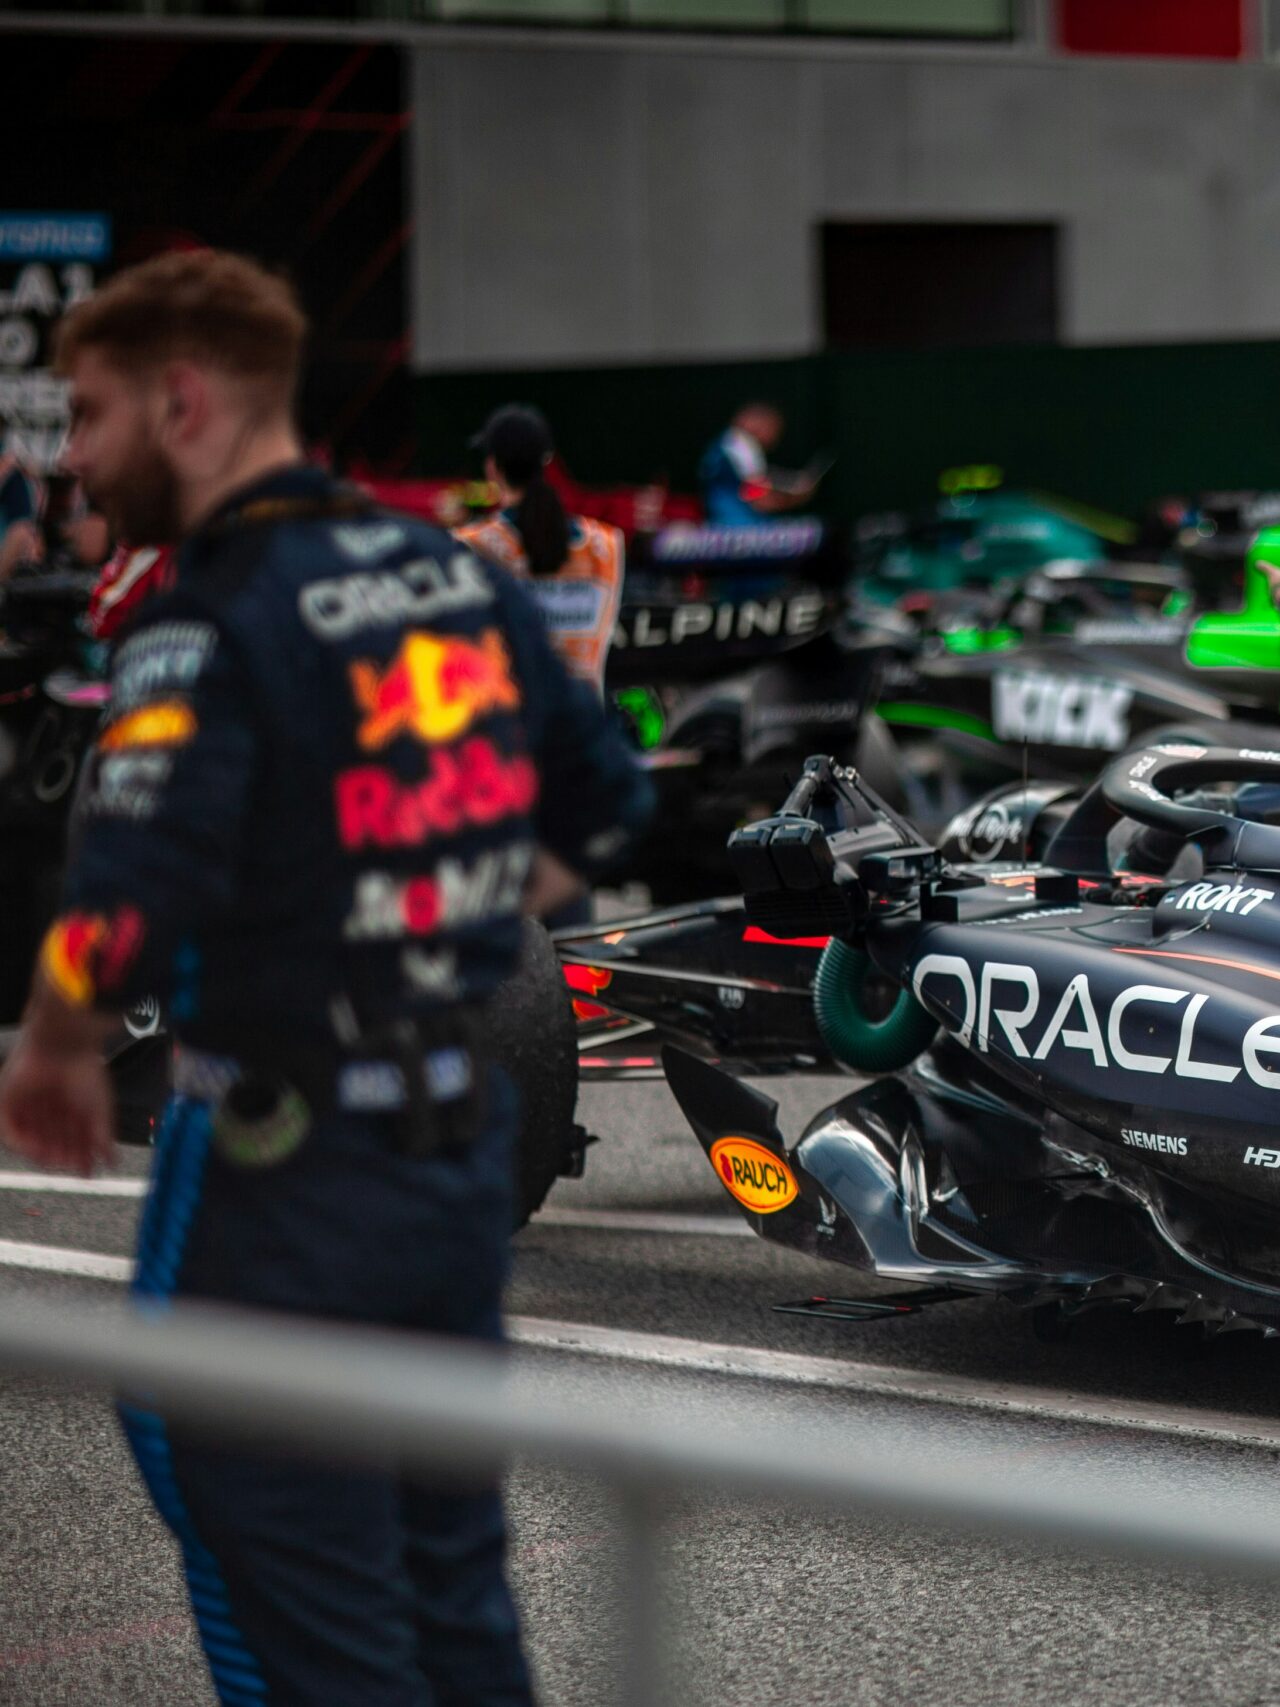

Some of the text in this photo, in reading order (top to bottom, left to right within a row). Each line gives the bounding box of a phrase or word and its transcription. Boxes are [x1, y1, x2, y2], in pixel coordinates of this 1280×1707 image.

[991, 669, 1134, 749] KICK
[1175, 882, 1275, 916] ROKT
[1120, 1128, 1187, 1156] SIEMENS
[731, 1156, 788, 1195] RAUCH
